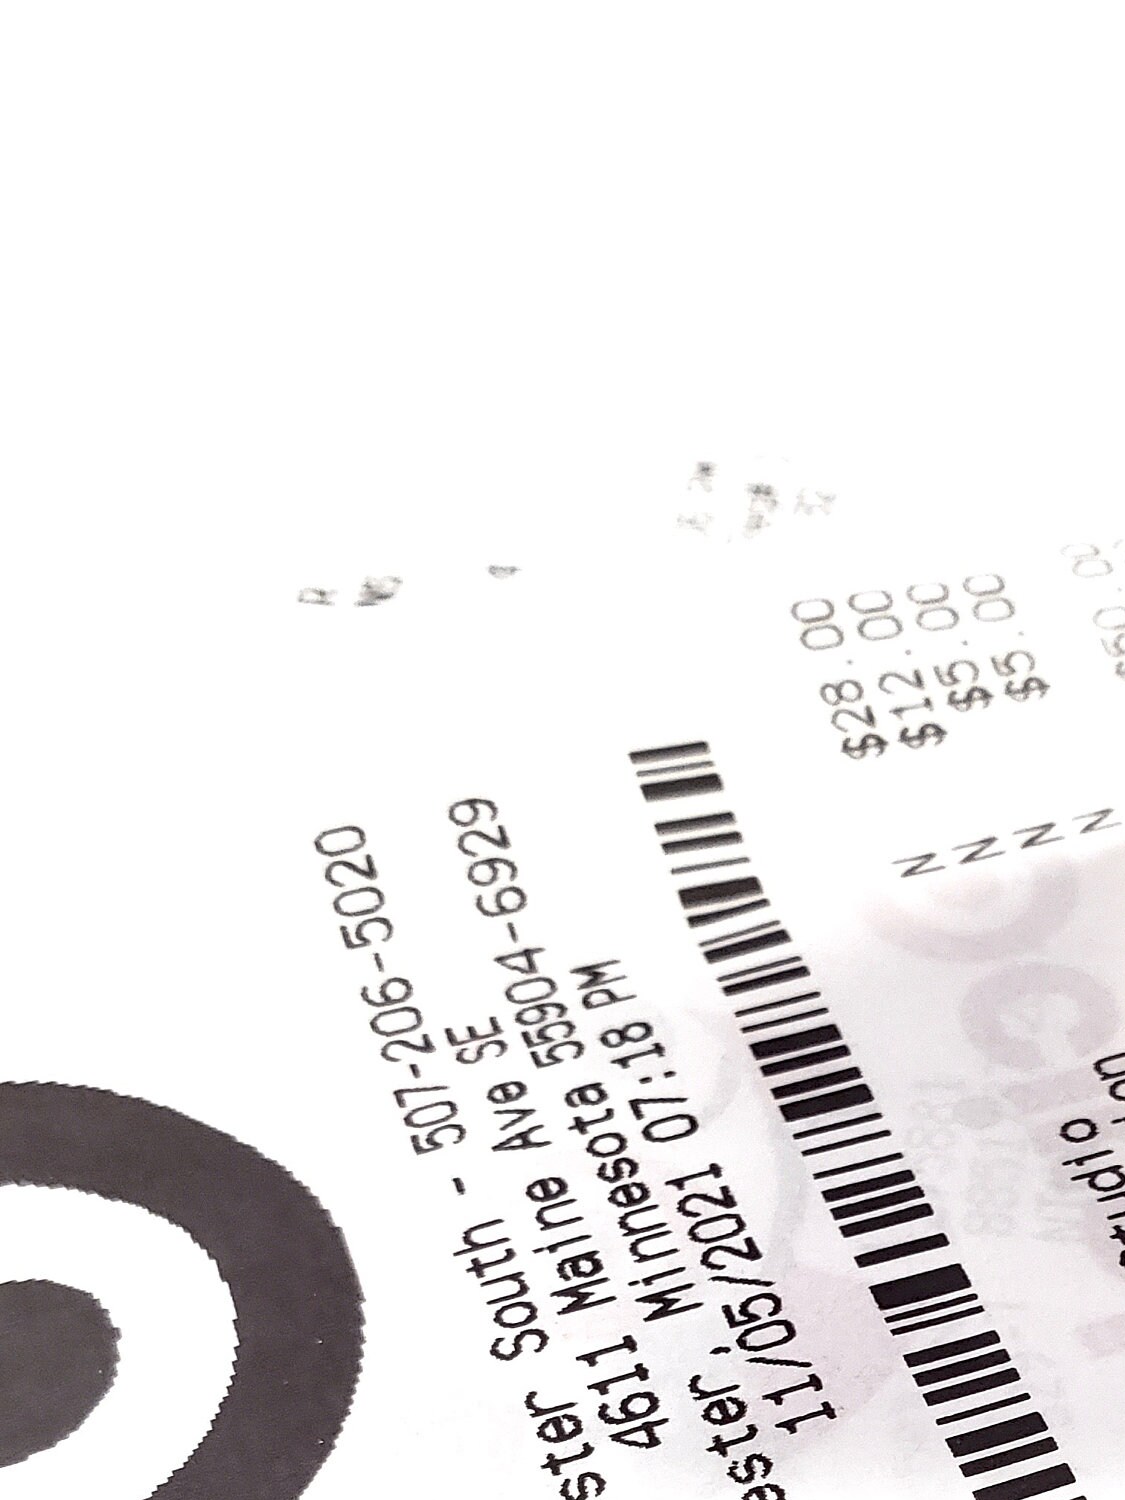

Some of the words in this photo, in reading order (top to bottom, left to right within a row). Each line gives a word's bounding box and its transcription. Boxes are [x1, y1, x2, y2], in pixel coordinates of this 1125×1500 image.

[790, 598, 889, 760] $28.00
[847, 590, 948, 750] $12.00
[905, 582, 994, 712] $5.00
[962, 573, 1051, 702] $5.00
[891, 852, 946, 878] N
[951, 836, 1006, 864] N
[1012, 822, 1065, 850] N
[1071, 808, 1122, 834] N
[314, 824, 468, 1156] 507-206-5020
[448, 797, 585, 1068] 55904-6929
[570, 958, 639, 1011] PM
[443, 1015, 509, 1067] SE
[600, 1018, 700, 1143] 07:18
[485, 1079, 554, 1153] Ave
[525, 1175, 619, 1316] Maine
[564, 1083, 704, 1322] Minnesota
[452, 1218, 549, 1363] South
[667, 1162, 837, 1435] 11/05/2021
[576, 1333, 661, 1450] 4611
